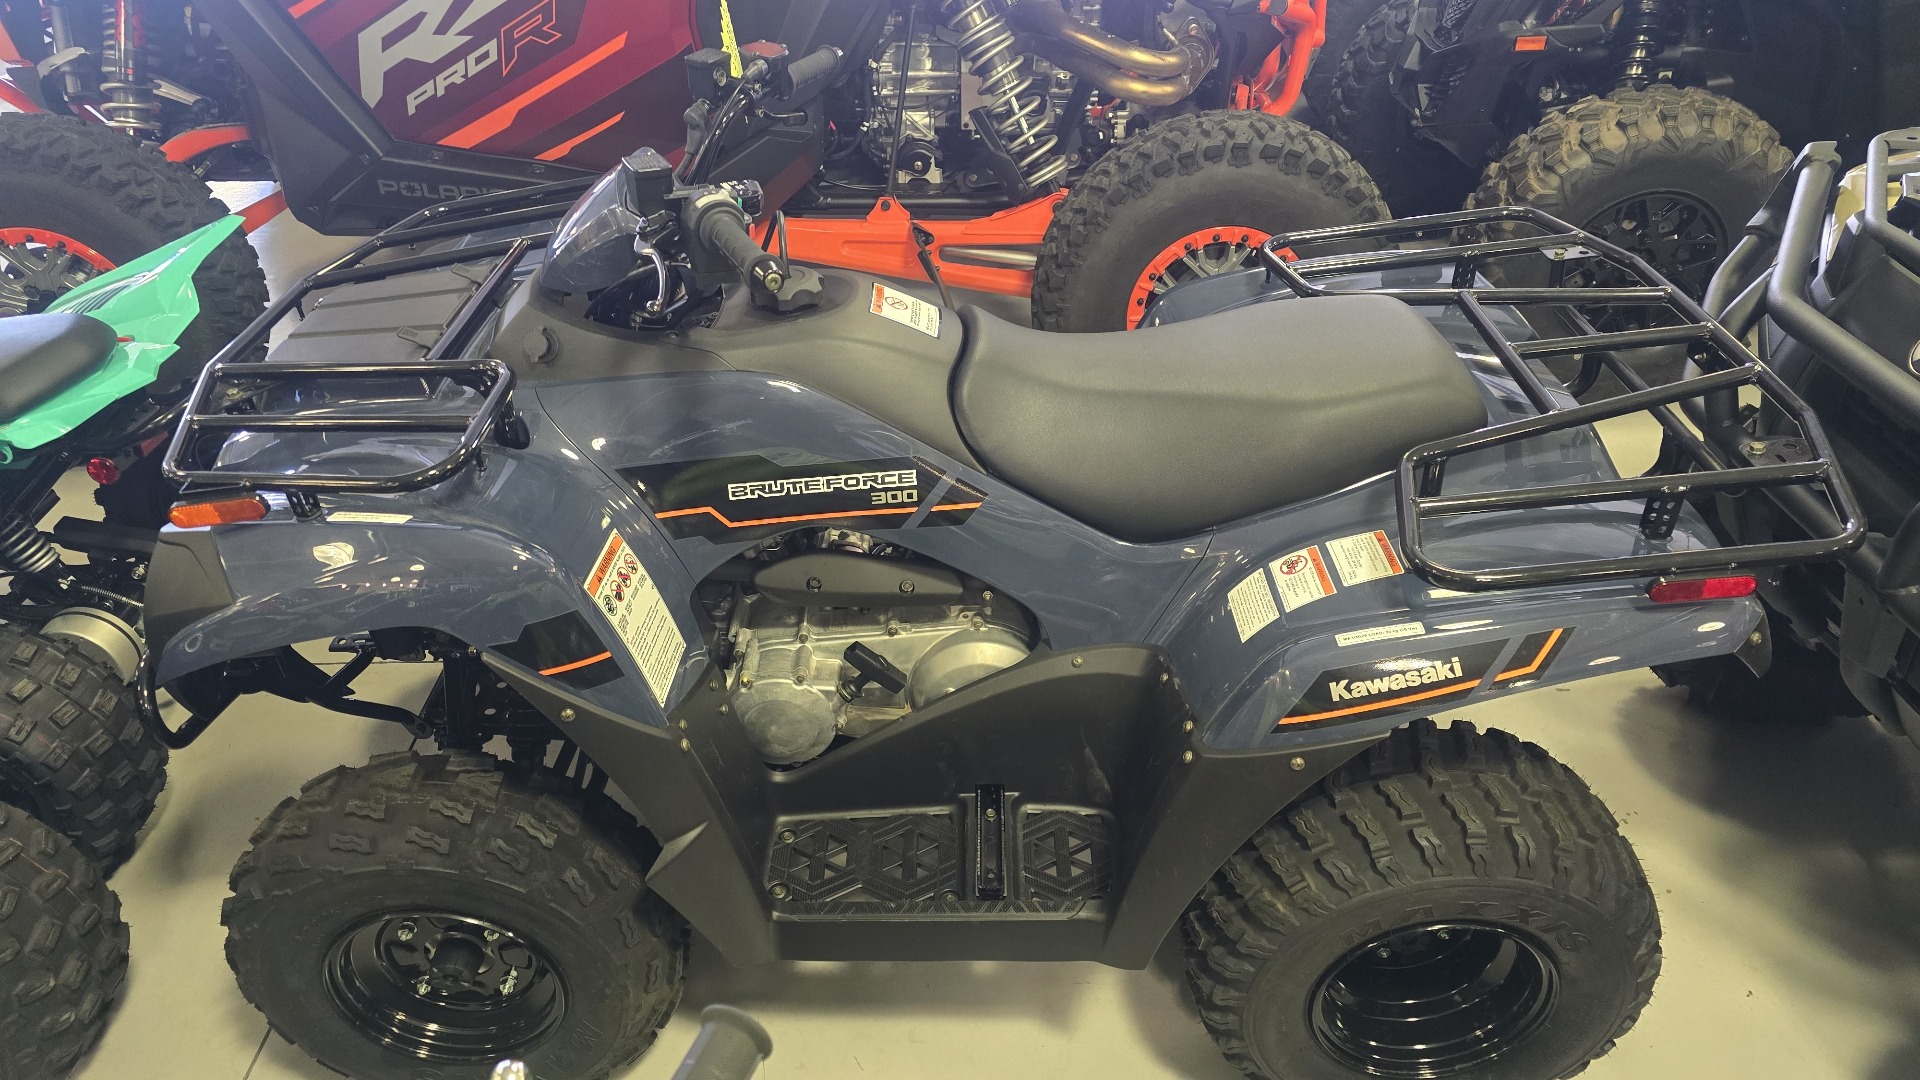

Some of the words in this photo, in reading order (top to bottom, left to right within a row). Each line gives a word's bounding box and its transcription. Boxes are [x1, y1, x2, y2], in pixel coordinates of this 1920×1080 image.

[406, 37, 498, 116] PRO
[501, 0, 562, 77] R
[377, 179, 507, 200] POLAR
[870, 489, 918, 505] 300
[599, 546, 616, 575] WARNING
[1329, 657, 1463, 702] Kawasaki
